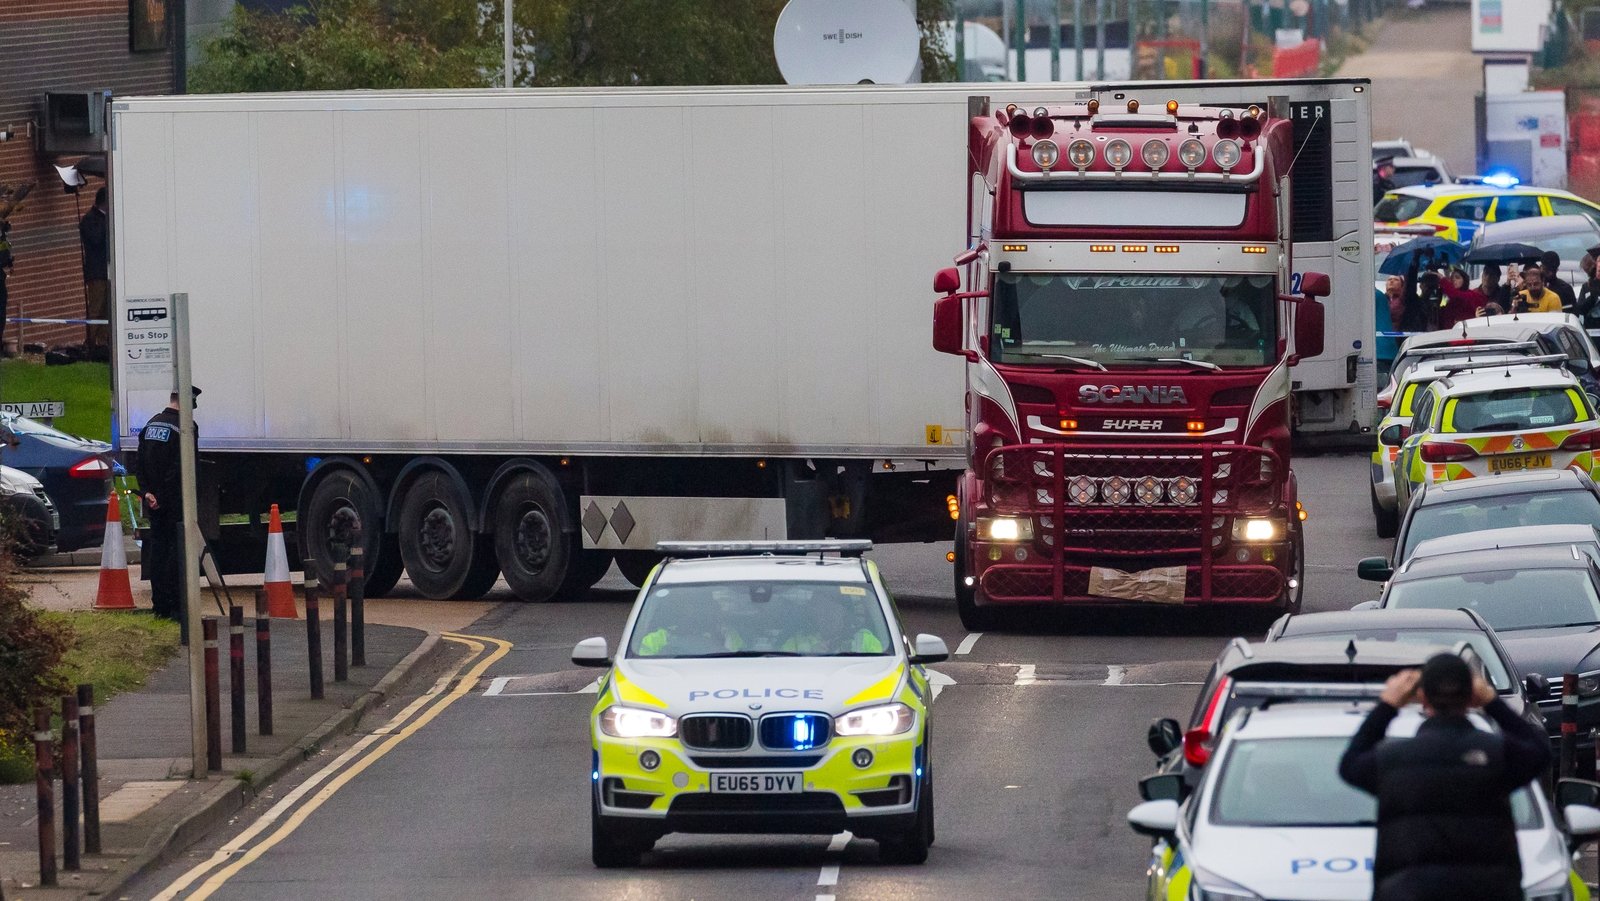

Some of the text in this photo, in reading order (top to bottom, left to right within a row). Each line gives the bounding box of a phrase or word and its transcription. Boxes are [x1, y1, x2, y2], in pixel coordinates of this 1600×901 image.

[1290, 106, 1324, 118] IER
[128, 331, 169, 340] Bus Stop
[1092, 343, 1107, 353] The
[1109, 343, 1146, 353] Ultimate
[1078, 384, 1188, 404] SCANIA
[0, 403, 54, 416] RN AVE
[1102, 420, 1163, 430] SUPER
[146, 427, 169, 439] POLICE
[1492, 457, 1521, 470] EU66
[688, 688, 824, 701] POLICE
[717, 776, 795, 791] EU65 DYV
